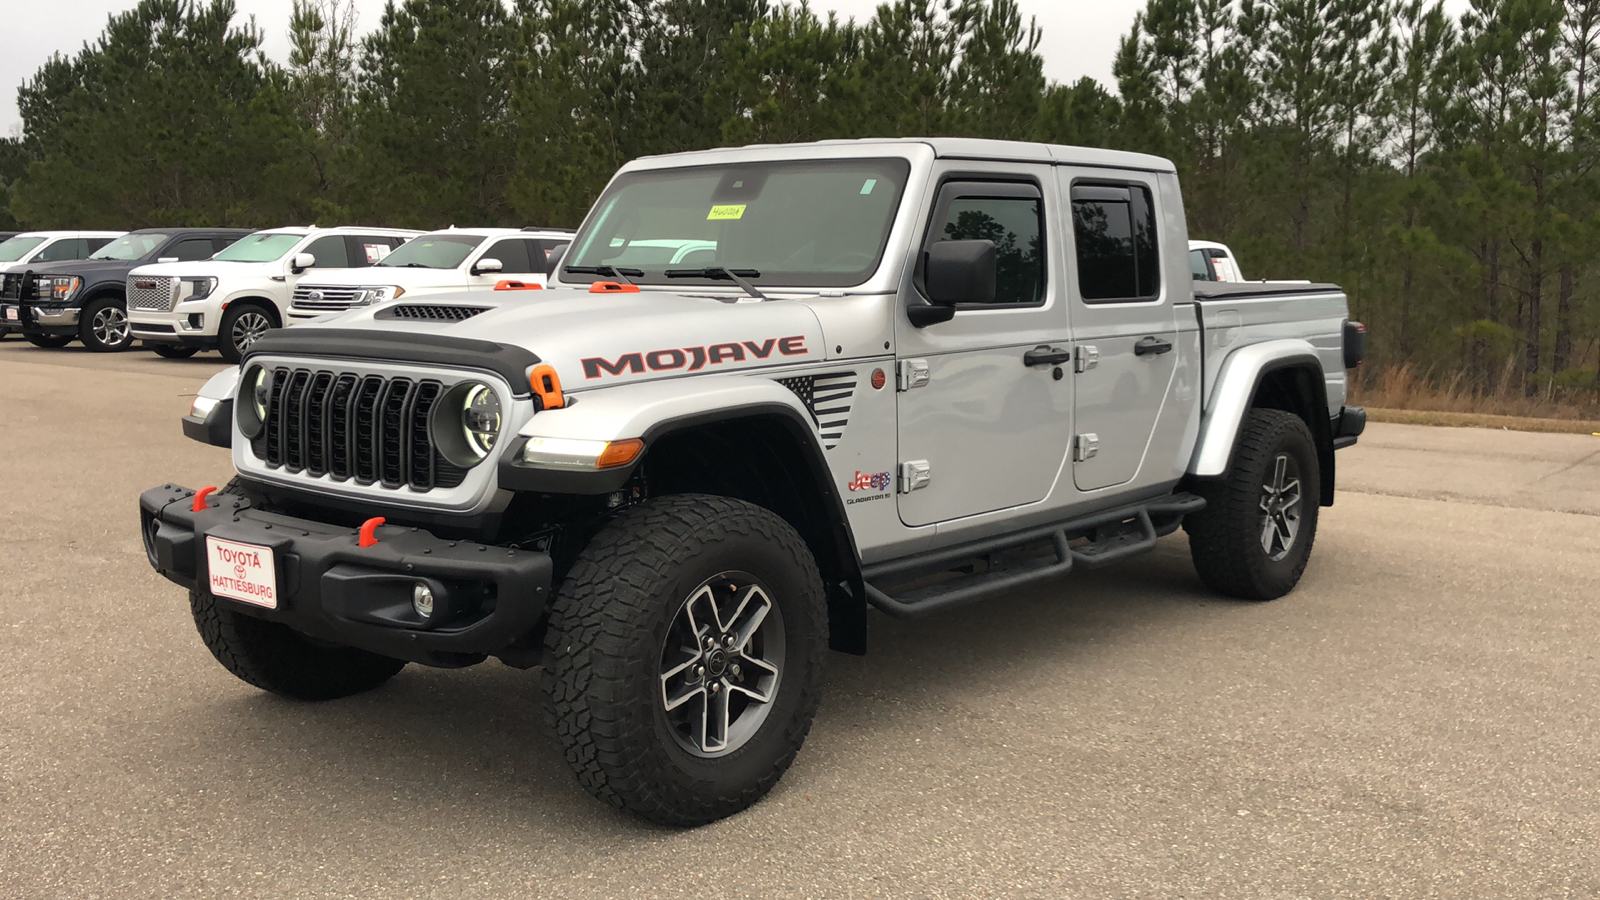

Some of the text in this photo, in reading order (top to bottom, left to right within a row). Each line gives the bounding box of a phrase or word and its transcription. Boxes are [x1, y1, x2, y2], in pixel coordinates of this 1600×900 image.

[580, 335, 808, 379] MOJAVE
[848, 470, 890, 491] Jeep
[846, 494, 884, 505] GLADIATOR
[217, 545, 261, 568] TOYOTA
[212, 574, 273, 599] HATTIESBURG
